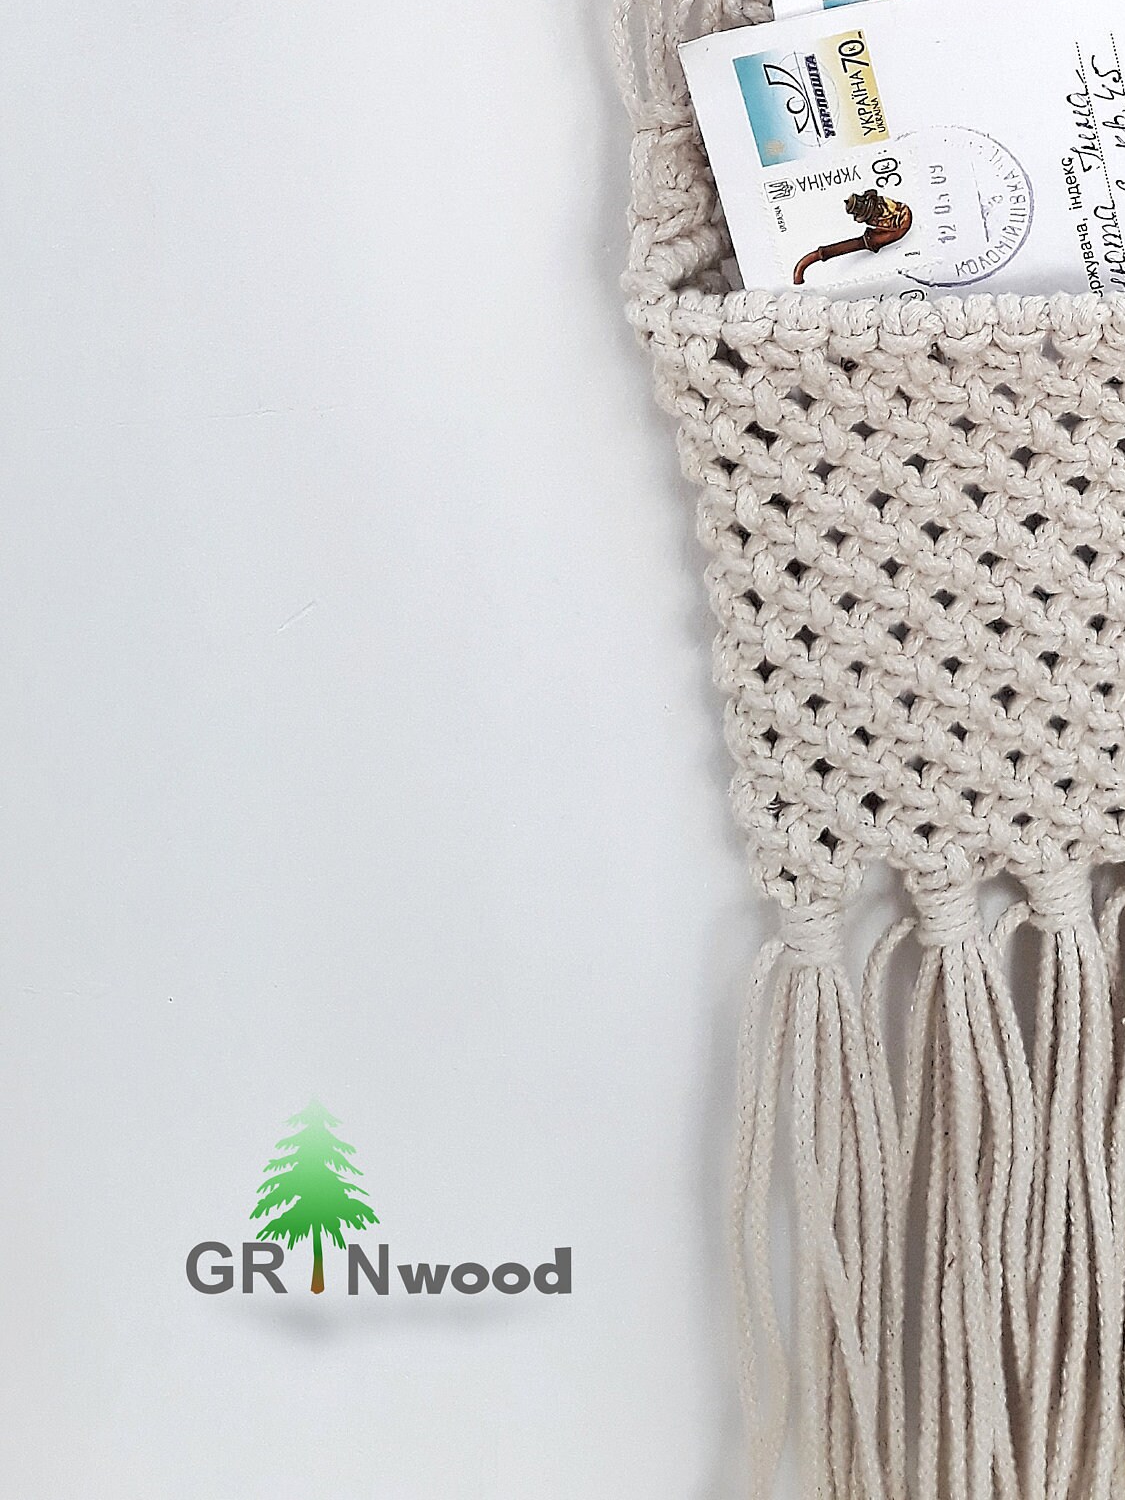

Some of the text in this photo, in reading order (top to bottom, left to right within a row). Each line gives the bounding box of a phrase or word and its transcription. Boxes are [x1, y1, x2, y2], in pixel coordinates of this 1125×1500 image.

[804, 53, 836, 139] УКРПОШТА
[849, 70, 876, 137] УКРАЇНА
[798, 165, 862, 192] УКРАЇНА
[1062, 156, 1083, 211] індекс
